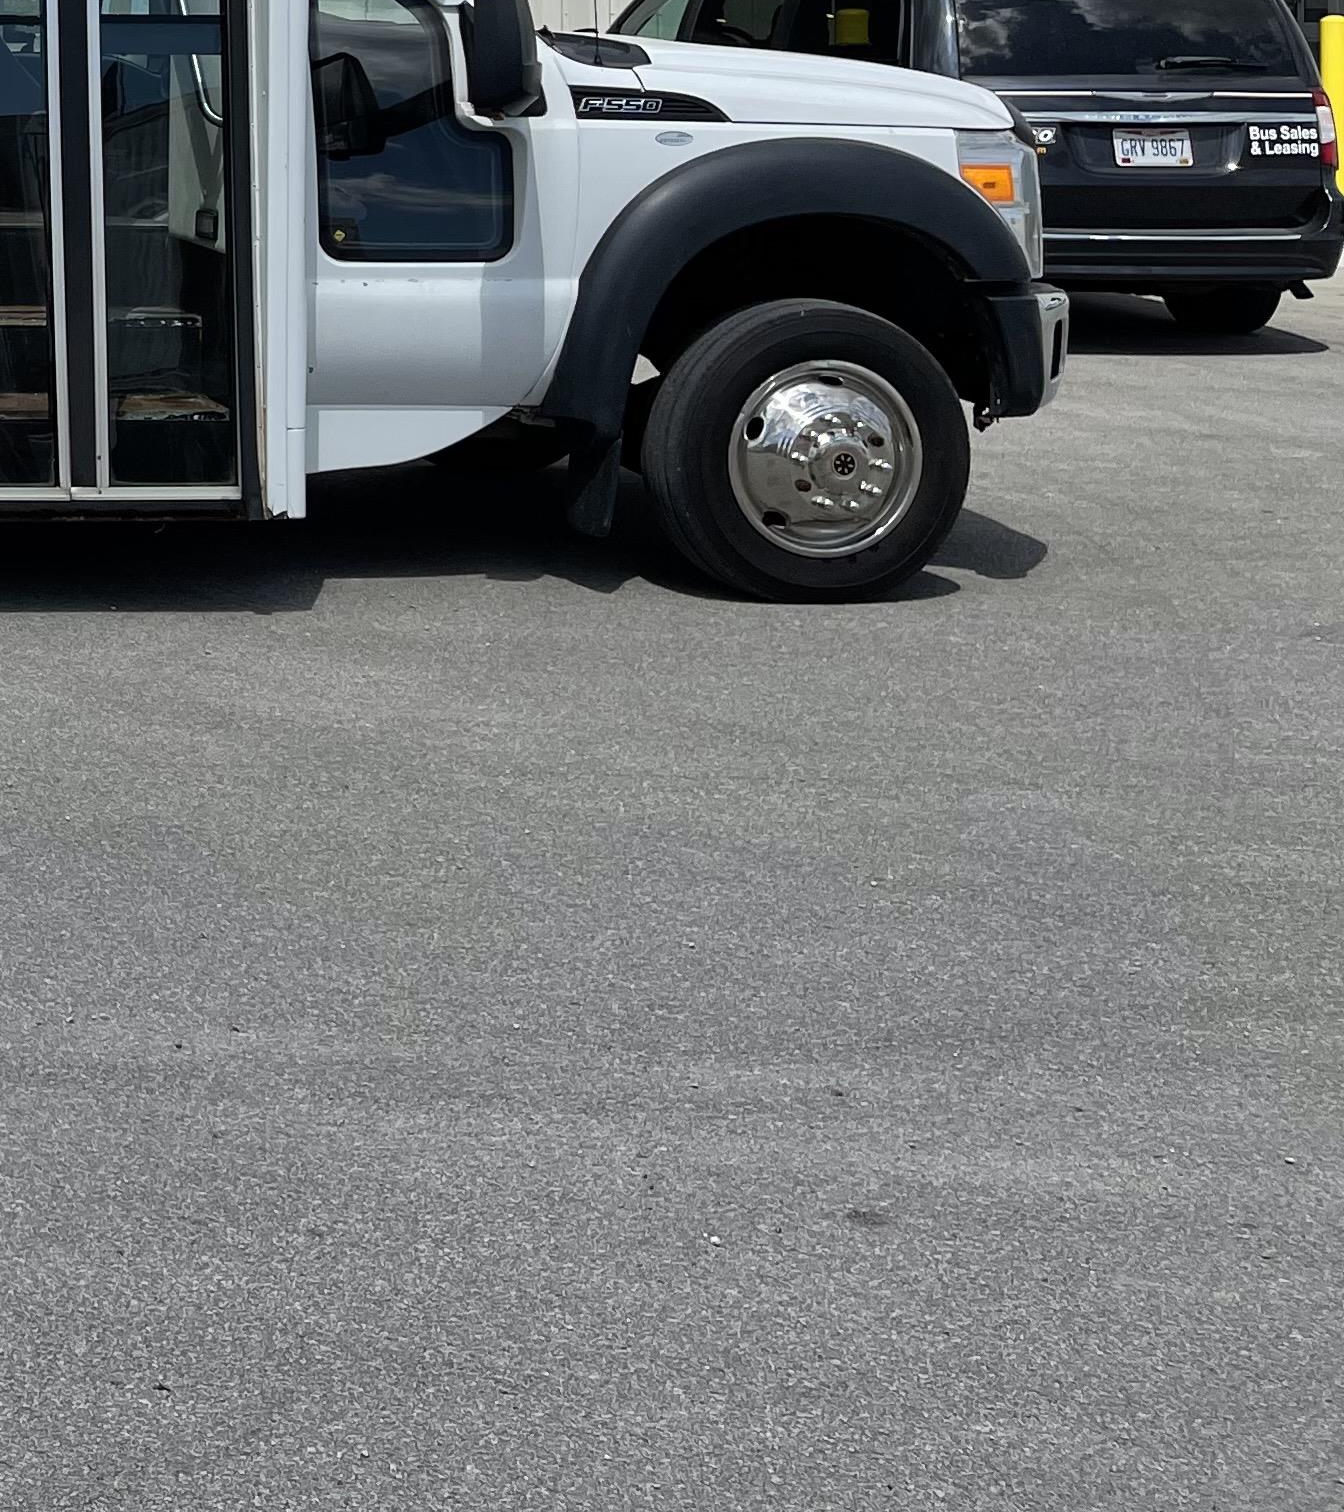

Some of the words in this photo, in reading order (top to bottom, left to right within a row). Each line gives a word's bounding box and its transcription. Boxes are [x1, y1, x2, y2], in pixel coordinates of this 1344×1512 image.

[577, 96, 663, 114] F-550
[1249, 125, 1278, 141] Bus
[1279, 125, 1318, 140] Sales
[1121, 138, 1146, 157] GRV
[1151, 138, 1185, 157] 9867
[1250, 140, 1262, 155] &
[1264, 140, 1320, 157] Leasing
